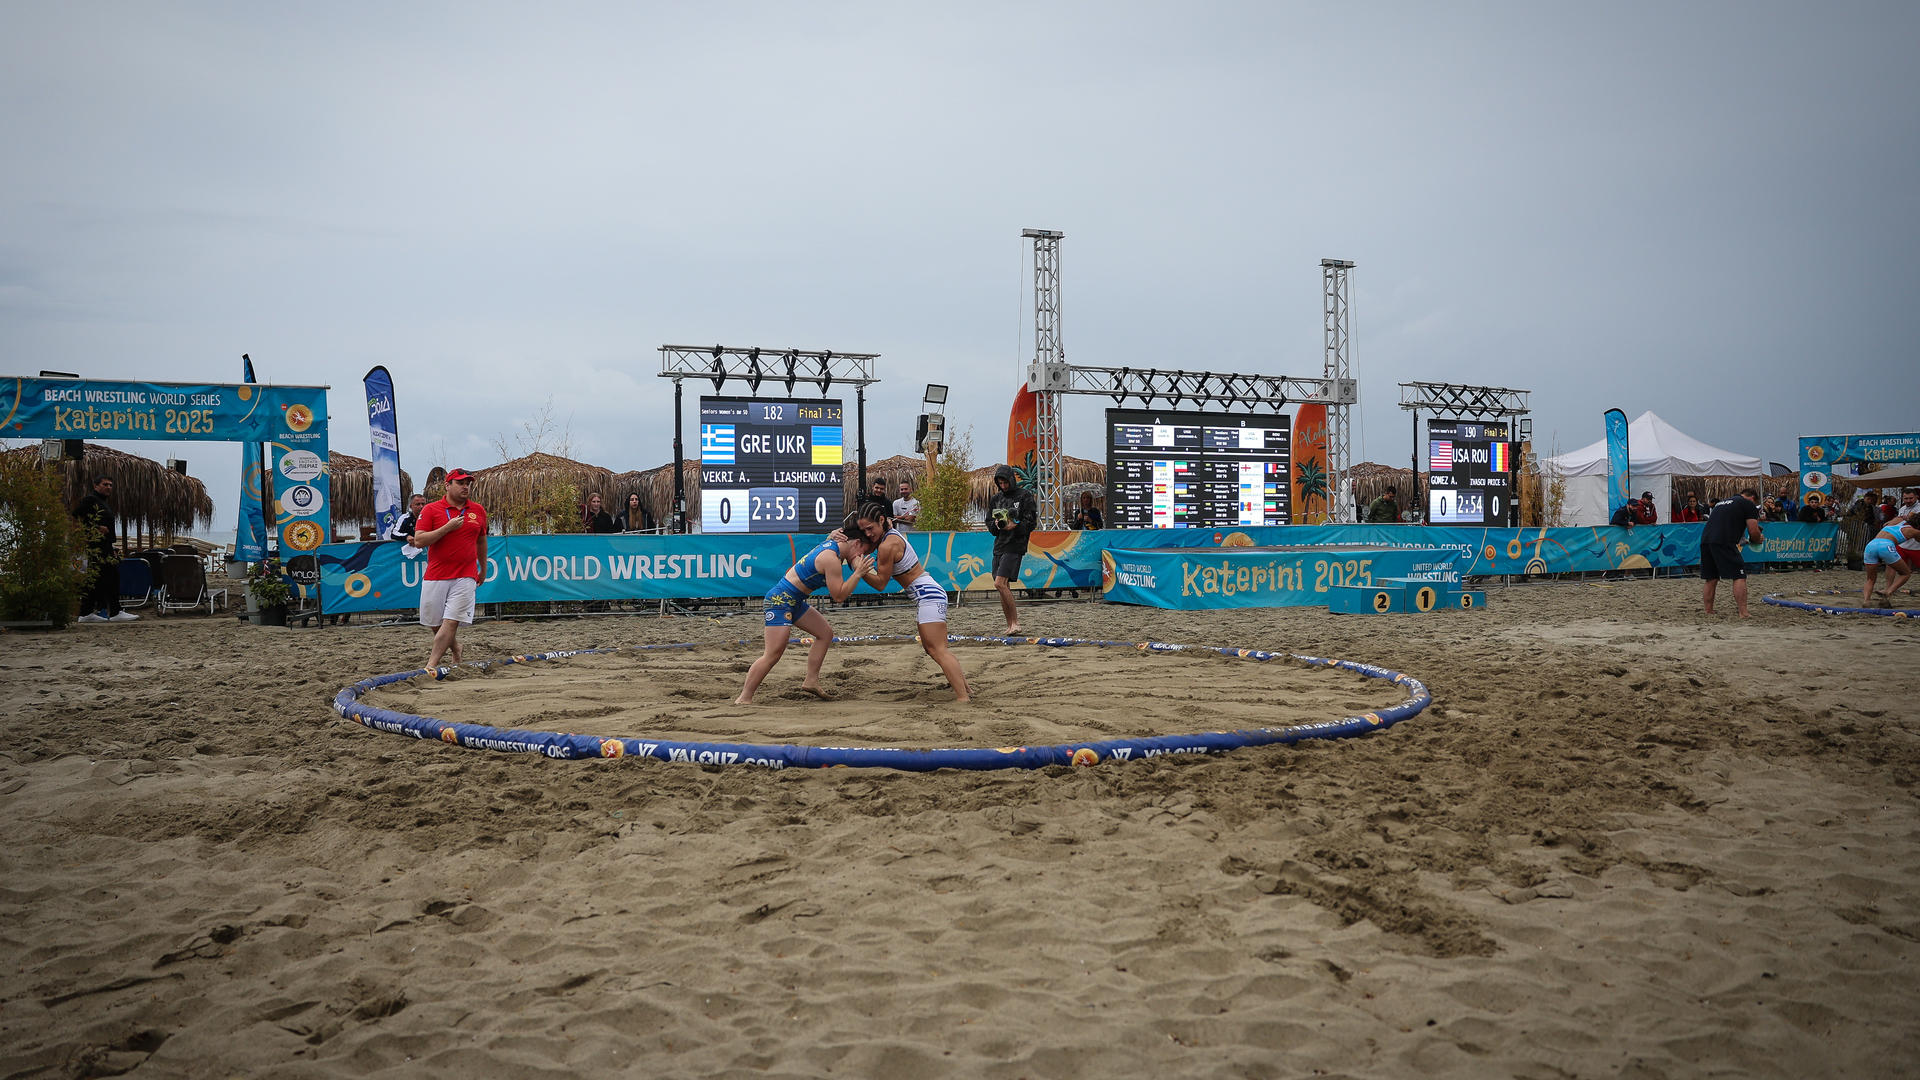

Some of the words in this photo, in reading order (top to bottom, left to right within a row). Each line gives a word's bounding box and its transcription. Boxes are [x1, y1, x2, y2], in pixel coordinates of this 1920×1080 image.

[44, 390, 80, 402] BEACH
[85, 390, 146, 404] WRESTLING
[150, 392, 186, 405] WORLD
[190, 394, 220, 406] SERIES
[54, 405, 156, 432] Katerini
[165, 409, 214, 433] 2025
[763, 406, 783, 420] 182
[800, 408, 822, 418] Final
[827, 408, 841, 419] 1-2
[1300, 420, 1326, 448] Aloh
[1464, 426, 1476, 438] 190
[1499, 429, 1508, 437] 3-4
[740, 434, 771, 453] GRE
[776, 435, 806, 454] UKR
[1452, 448, 1469, 463] USA
[1472, 449, 1488, 463] ROU
[1864, 446, 1920, 461] Katerini
[702, 471, 733, 482] VEKRI
[740, 471, 750, 482] A.
[774, 472, 826, 483] LIASHENKO
[830, 472, 840, 483] A.
[1431, 476, 1448, 485] GOMEZ
[1451, 476, 1458, 485] A.
[720, 498, 731, 524] 0
[752, 496, 796, 520] 2:53
[816, 496, 826, 524] 0
[1441, 496, 1447, 516] 0
[1457, 495, 1483, 514] 2:54
[1492, 496, 1499, 516] 0
[1765, 537, 1805, 552] Katerini
[1808, 538, 1832, 552] 2025
[505, 555, 601, 582] WORLD
[608, 554, 752, 580] WRESTLING
[1120, 564, 1137, 572] UNITED
[1138, 565, 1152, 574] WORLD
[1413, 563, 1432, 571] UNITED
[1433, 563, 1453, 571] WORLD
[1116, 572, 1156, 589] WRESTLING
[1181, 560, 1304, 597] Katerini
[1315, 560, 1372, 592] 2025
[1378, 594, 1387, 608] 2
[1421, 591, 1429, 608] 1
[1463, 597, 1470, 607] 3
[464, 736, 570, 758] BEACHWRESTLINGORG
[668, 748, 784, 770] YALOUZCOM
